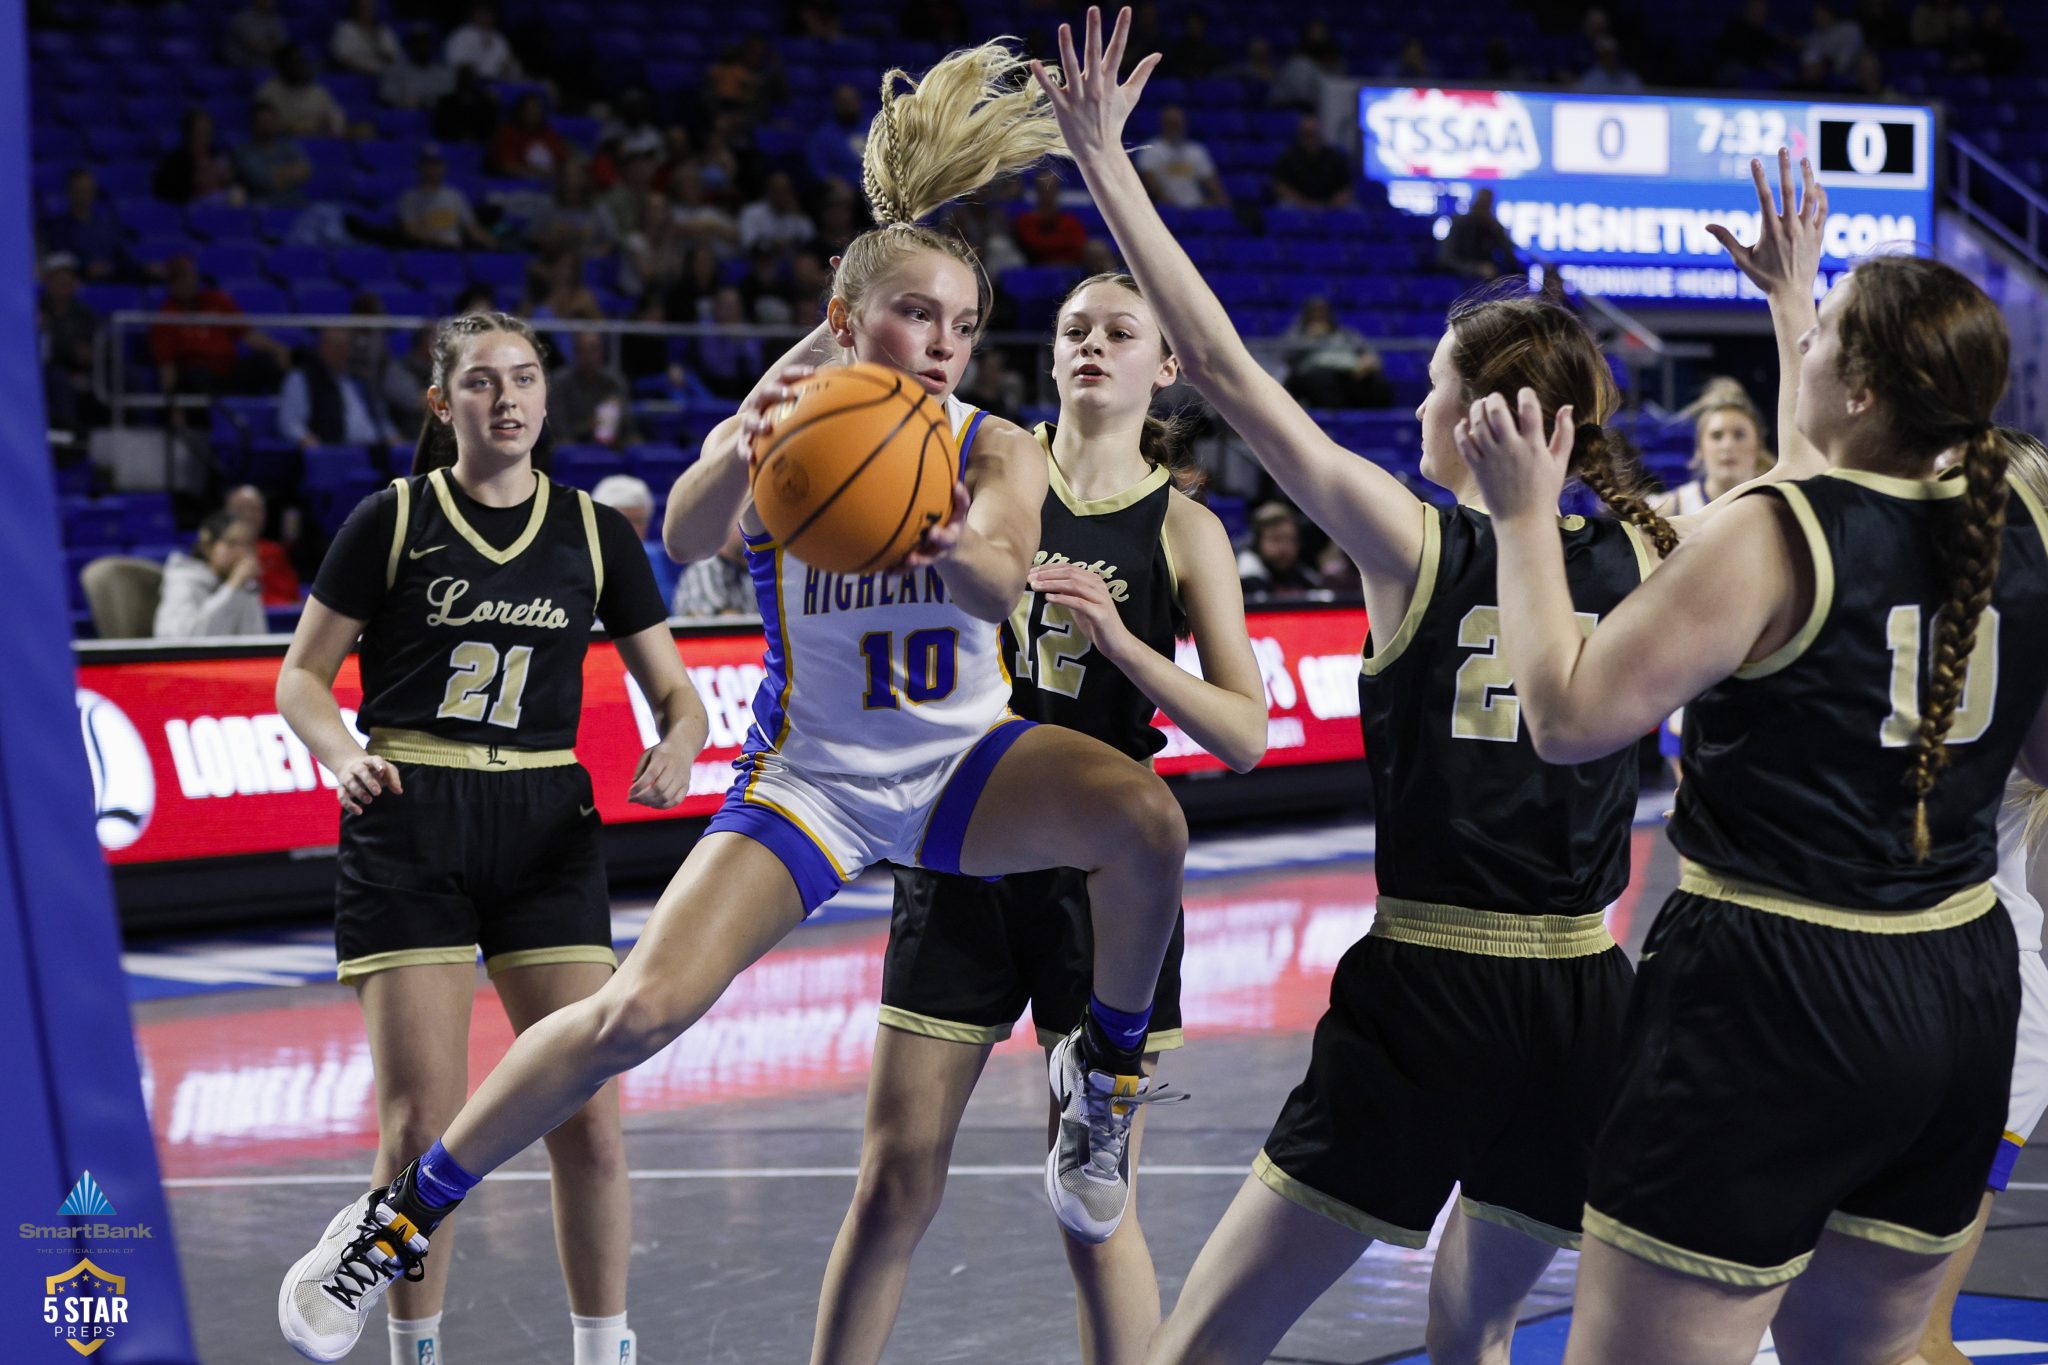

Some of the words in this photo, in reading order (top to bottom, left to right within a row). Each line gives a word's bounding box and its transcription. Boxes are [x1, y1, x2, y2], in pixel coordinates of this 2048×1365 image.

[1383, 114, 1527, 156] TSSAA
[1597, 116, 1626, 161] 0
[1694, 107, 1787, 155] 7:32
[1847, 120, 1888, 175] 0
[426, 576, 569, 629] Loretto
[803, 564, 953, 615] HIGHLAN
[859, 626, 959, 711] 10
[1008, 590, 1092, 700] 12
[436, 640, 535, 729] 21
[1879, 604, 1999, 747] 10
